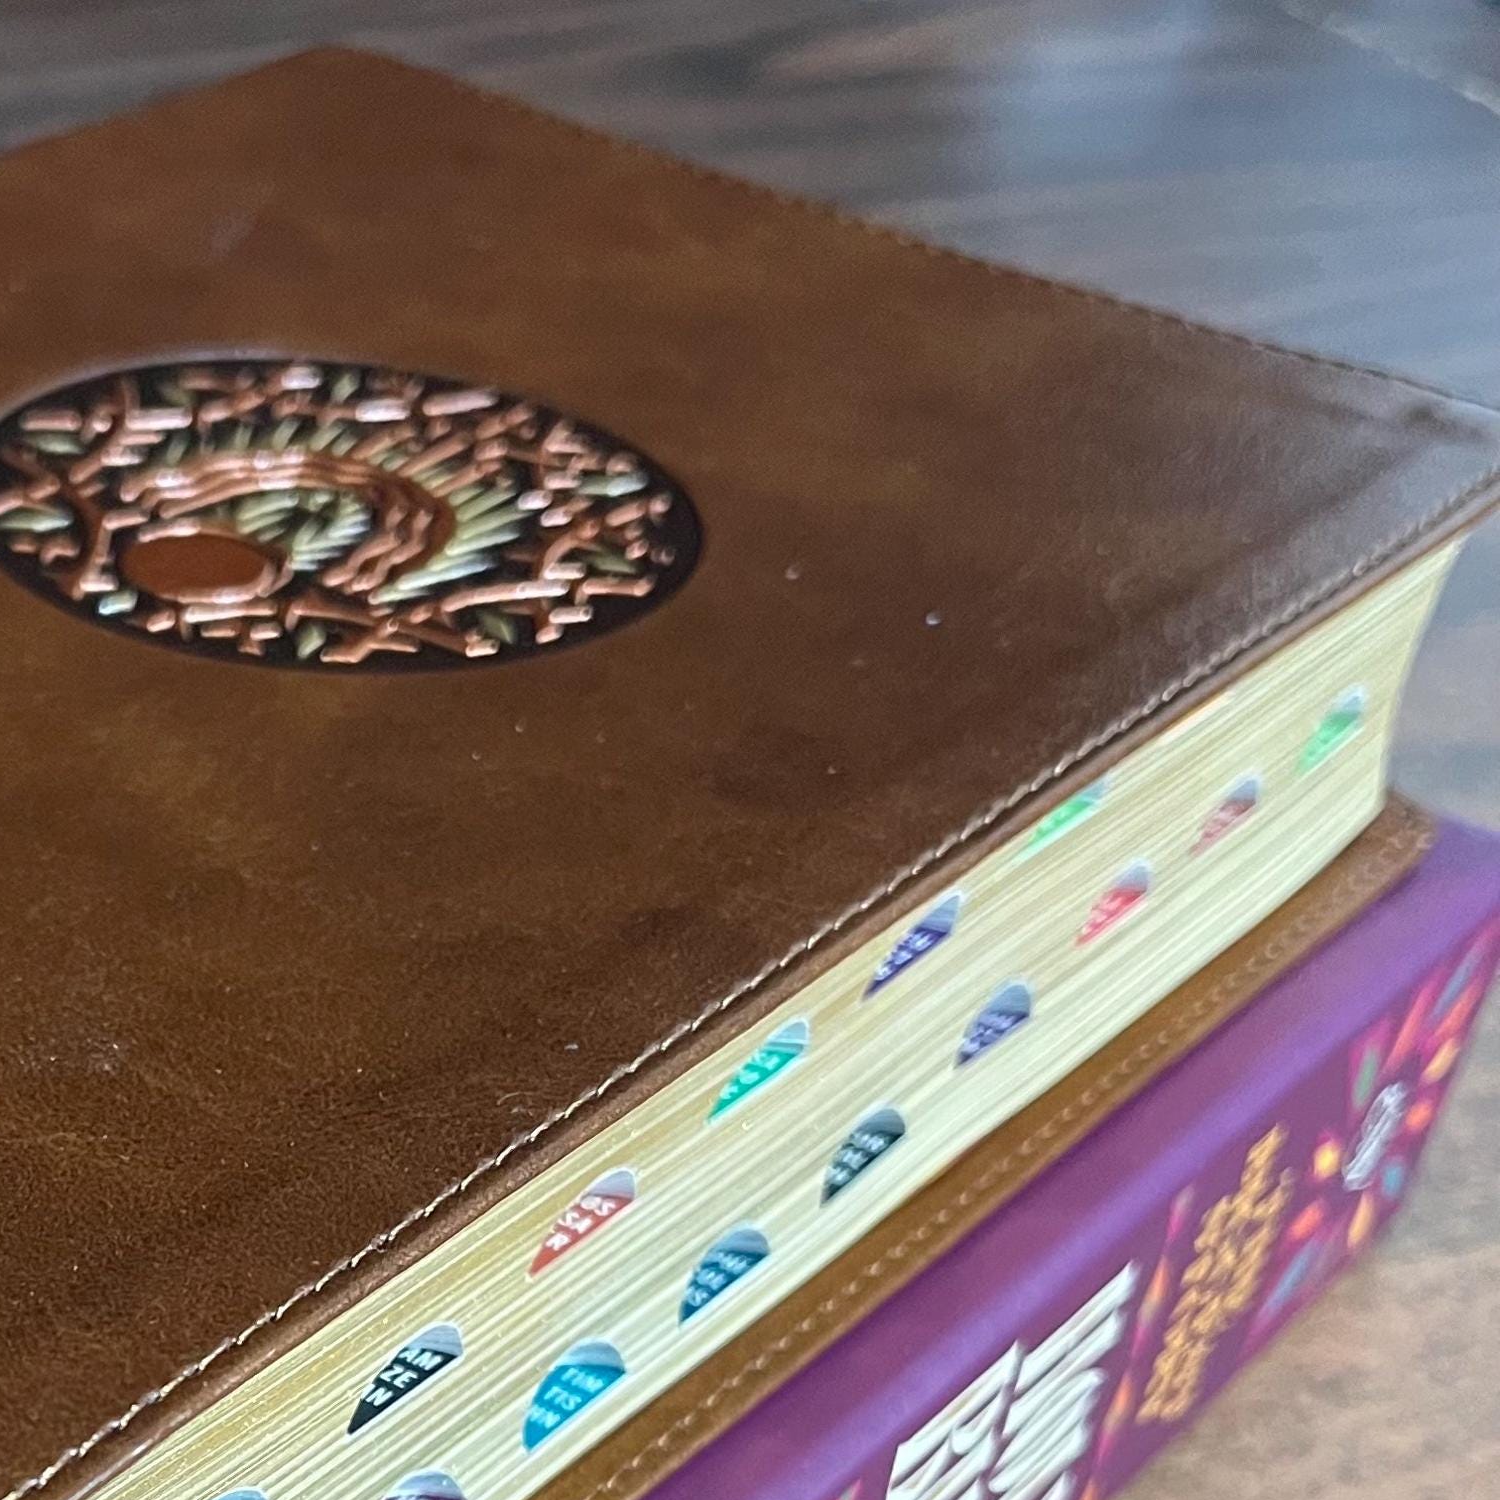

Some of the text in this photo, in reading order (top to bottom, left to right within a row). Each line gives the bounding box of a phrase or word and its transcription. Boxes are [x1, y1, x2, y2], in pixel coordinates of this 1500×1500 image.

[558, 1211, 593, 1234] SA
[399, 1347, 445, 1372] AM
[380, 1364, 418, 1389] ZE
